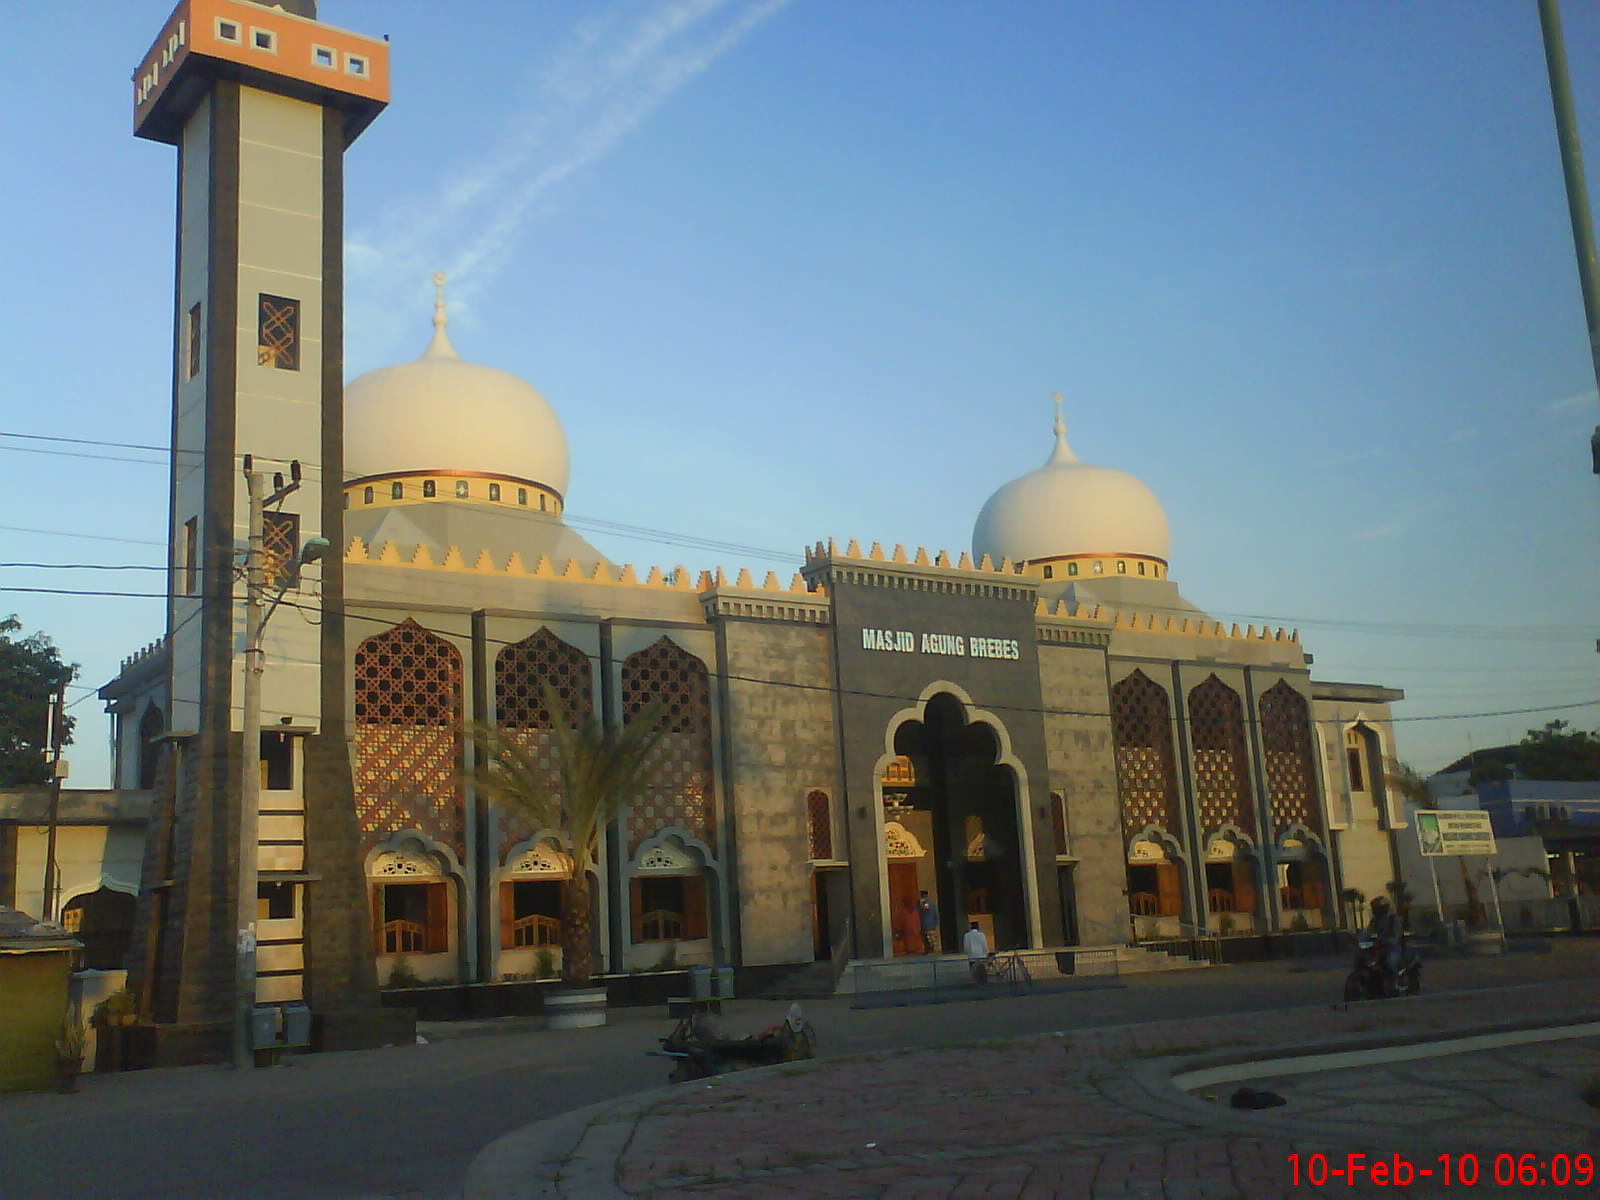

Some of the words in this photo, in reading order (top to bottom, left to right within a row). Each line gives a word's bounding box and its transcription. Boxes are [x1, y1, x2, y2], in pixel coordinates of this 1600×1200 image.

[862, 627, 914, 652] MASJID
[921, 633, 965, 656] AGUNG
[969, 637, 1019, 660] BREBES
